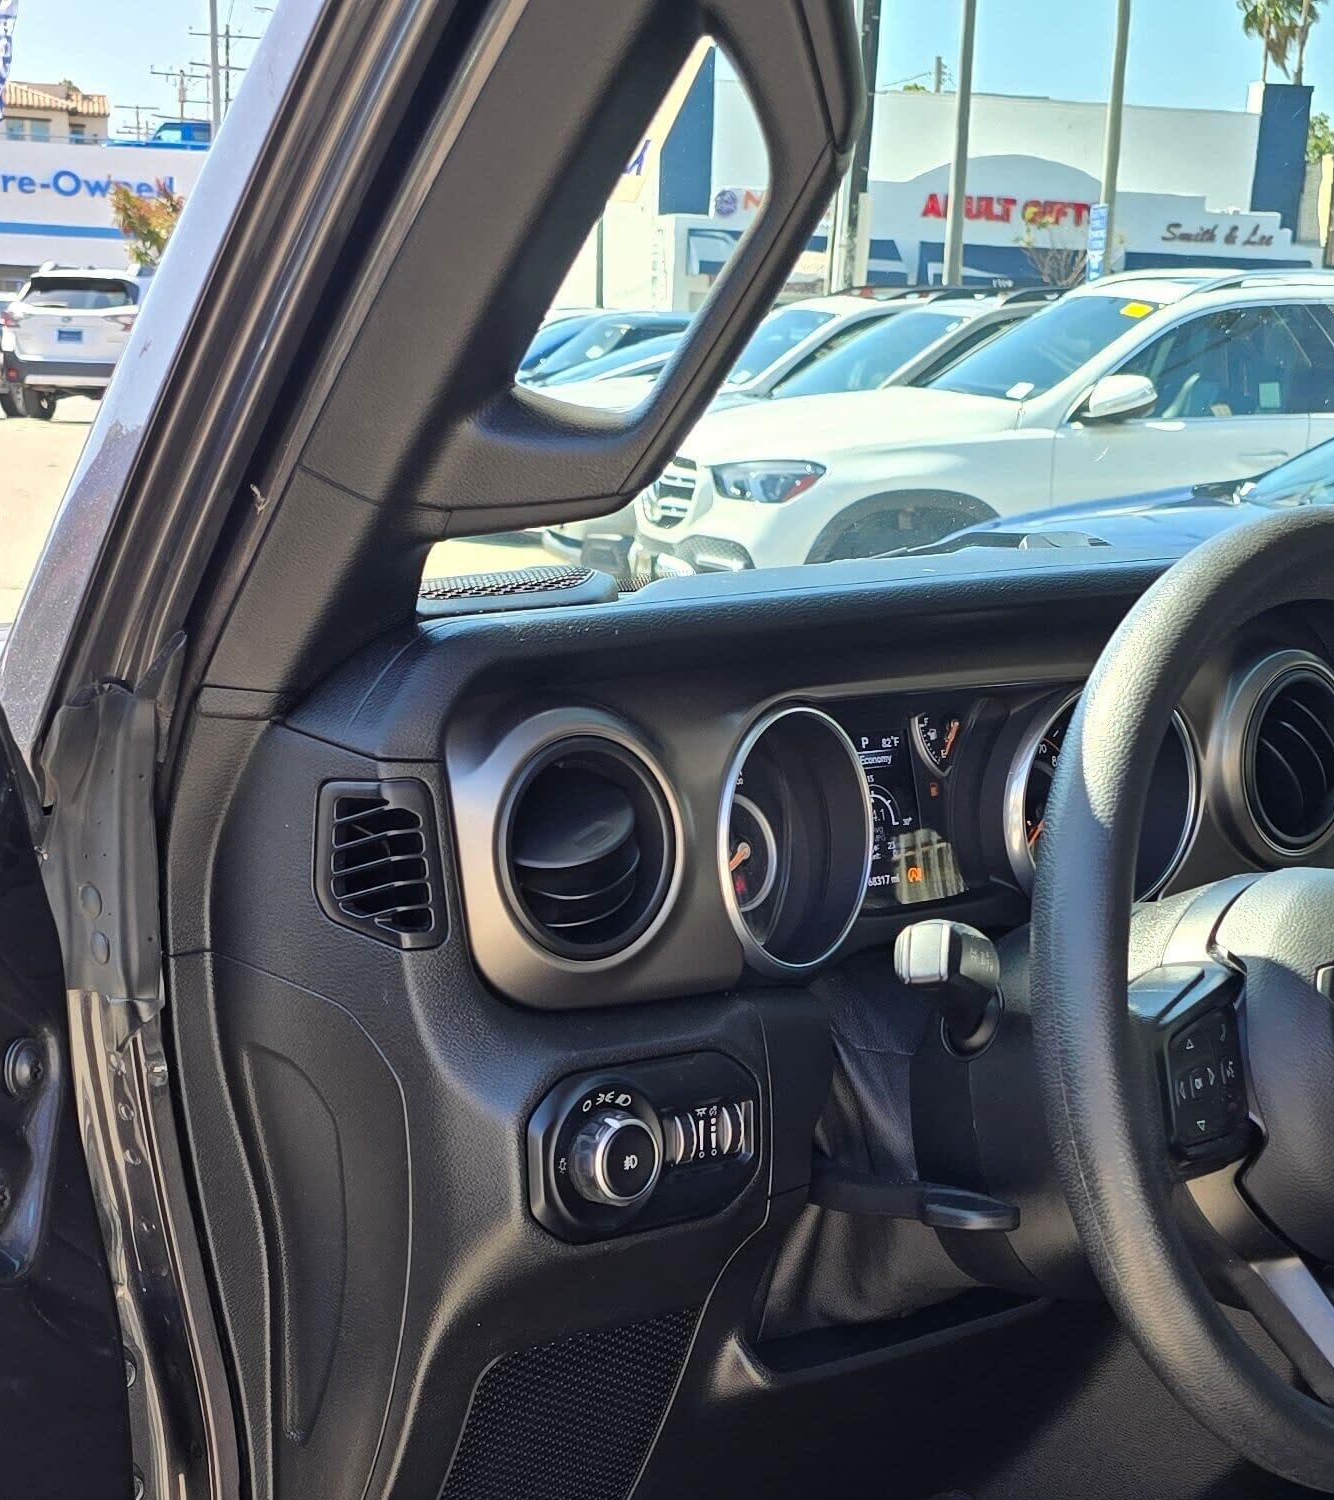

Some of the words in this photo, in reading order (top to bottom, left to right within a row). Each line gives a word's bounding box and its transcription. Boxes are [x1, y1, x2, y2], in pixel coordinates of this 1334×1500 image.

[921, 193, 1016, 223] AULT
[1161, 223, 1219, 243] Smith
[1223, 225, 1239, 245] &
[1242, 224, 1274, 247] Lee
[861, 737, 869, 748] P
